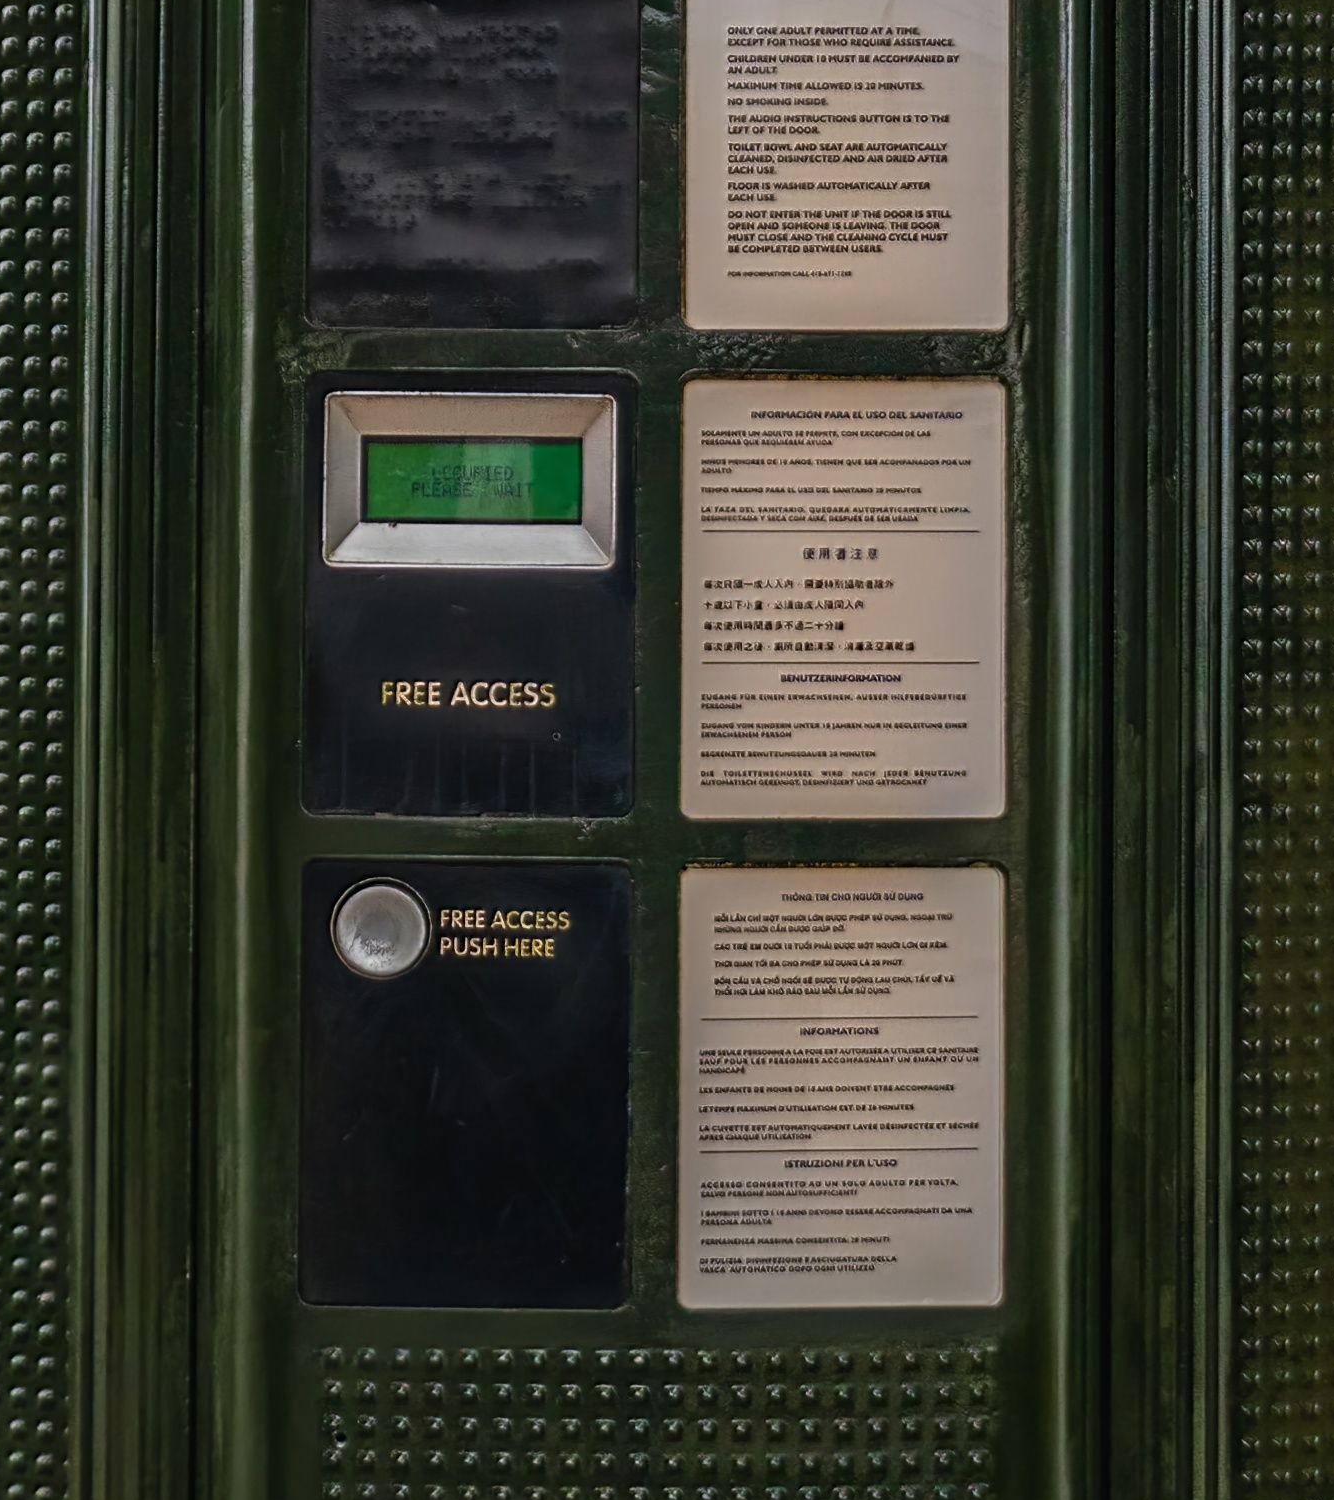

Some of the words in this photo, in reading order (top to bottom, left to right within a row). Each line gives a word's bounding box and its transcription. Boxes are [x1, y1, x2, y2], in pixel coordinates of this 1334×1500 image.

[727, 27, 754, 36] ONLY
[756, 27, 778, 36] ONE
[779, 27, 812, 36] ADULT
[814, 27, 869, 36] PERMITTED
[871, 27, 884, 36] AT
[885, 27, 894, 36] A
[727, 38, 765, 47] EXCEPT
[767, 38, 787, 47] FOR
[789, 38, 821, 47] THOSE
[823, 38, 848, 47] WHO
[850, 38, 892, 47] REQUIRE
[727, 55, 777, 63] CHILDREN
[779, 55, 814, 63] UNDER
[828, 55, 857, 63] MUST
[858, 55, 871, 63] BE
[873, 55, 945, 63] ACCOMPANIED
[946, 55, 960, 64] BY
[727, 66, 743, 75] AN
[727, 82, 778, 90] MAXIMUM
[781, 82, 803, 90] TIME
[805, 82, 852, 91] ALLOWED
[854, 82, 863, 90] IS
[727, 98, 744, 106] NO
[745, 98, 792, 106] SMOKING
[729, 115, 747, 123] THE
[749, 115, 782, 123] AUDIO
[783, 115, 857, 123] INSTRUCTIONS
[859, 114, 901, 123] BUTTON
[902, 115, 913, 123] IS
[915, 115, 929, 123] TO
[931, 114, 951, 124] THE
[727, 126, 750, 135] LEFT
[752, 126, 765, 135] OF
[768, 126, 787, 135] THE
[729, 143, 762, 152] TOILET
[763, 143, 792, 152] BOWL
[794, 143, 817, 152] AND
[819, 143, 843, 152] SEAT
[845, 143, 864, 152] ARE
[866, 143, 948, 152] AUTOMATICALLY
[728, 155, 775, 163] CLEANED,
[777, 155, 841, 163] DISINFECTED
[843, 155, 865, 163] AND
[867, 155, 884, 163] AIR
[885, 154, 916, 163] DRIED
[917, 154, 948, 163] AFTER
[727, 166, 754, 175] EACH
[727, 182, 760, 190] FLOOR
[761, 182, 771, 190] IS
[773, 182, 815, 190] WASHED
[817, 182, 898, 190] AUTOMATICALLY
[900, 182, 931, 190] AFTER
[727, 194, 755, 202] EACH
[727, 210, 743, 219] DO
[745, 210, 767, 219] NOT
[769, 210, 801, 219] ENTER
[804, 210, 823, 219] THE
[824, 210, 849, 219] UNIT
[851, 210, 860, 219] IF
[863, 210, 882, 219] THE
[883, 210, 913, 219] DOOR
[914, 210, 924, 219] IS
[926, 210, 952, 219] STILL
[728, 222, 755, 230] OPEN
[757, 222, 779, 230] AND
[782, 222, 830, 230] SOMEONE
[832, 222, 841, 230] IS
[843, 222, 887, 230] LEAVING.
[891, 222, 909, 230] THE
[910, 222, 941, 230] DOOR
[727, 234, 755, 242] MUST
[757, 234, 788, 242] CLOSE
[790, 234, 813, 242] AND
[816, 233, 835, 242] THE
[836, 234, 887, 242] CLEANING
[888, 233, 919, 242] CYCLE
[921, 233, 949, 242] MUST
[727, 245, 740, 254] BE
[742, 245, 801, 254] COMPLETED
[803, 245, 849, 254] BETWEEN
[780, 674, 902, 683] BENUTZERINFORMATION
[381, 681, 441, 706] FREE
[450, 681, 556, 706] ACCESS
[440, 909, 487, 929] FREE
[490, 910, 571, 930] ACCESS
[439, 937, 498, 957] PUSH
[504, 938, 556, 958] HERE
[799, 1027, 880, 1036] INFORMATIONS
